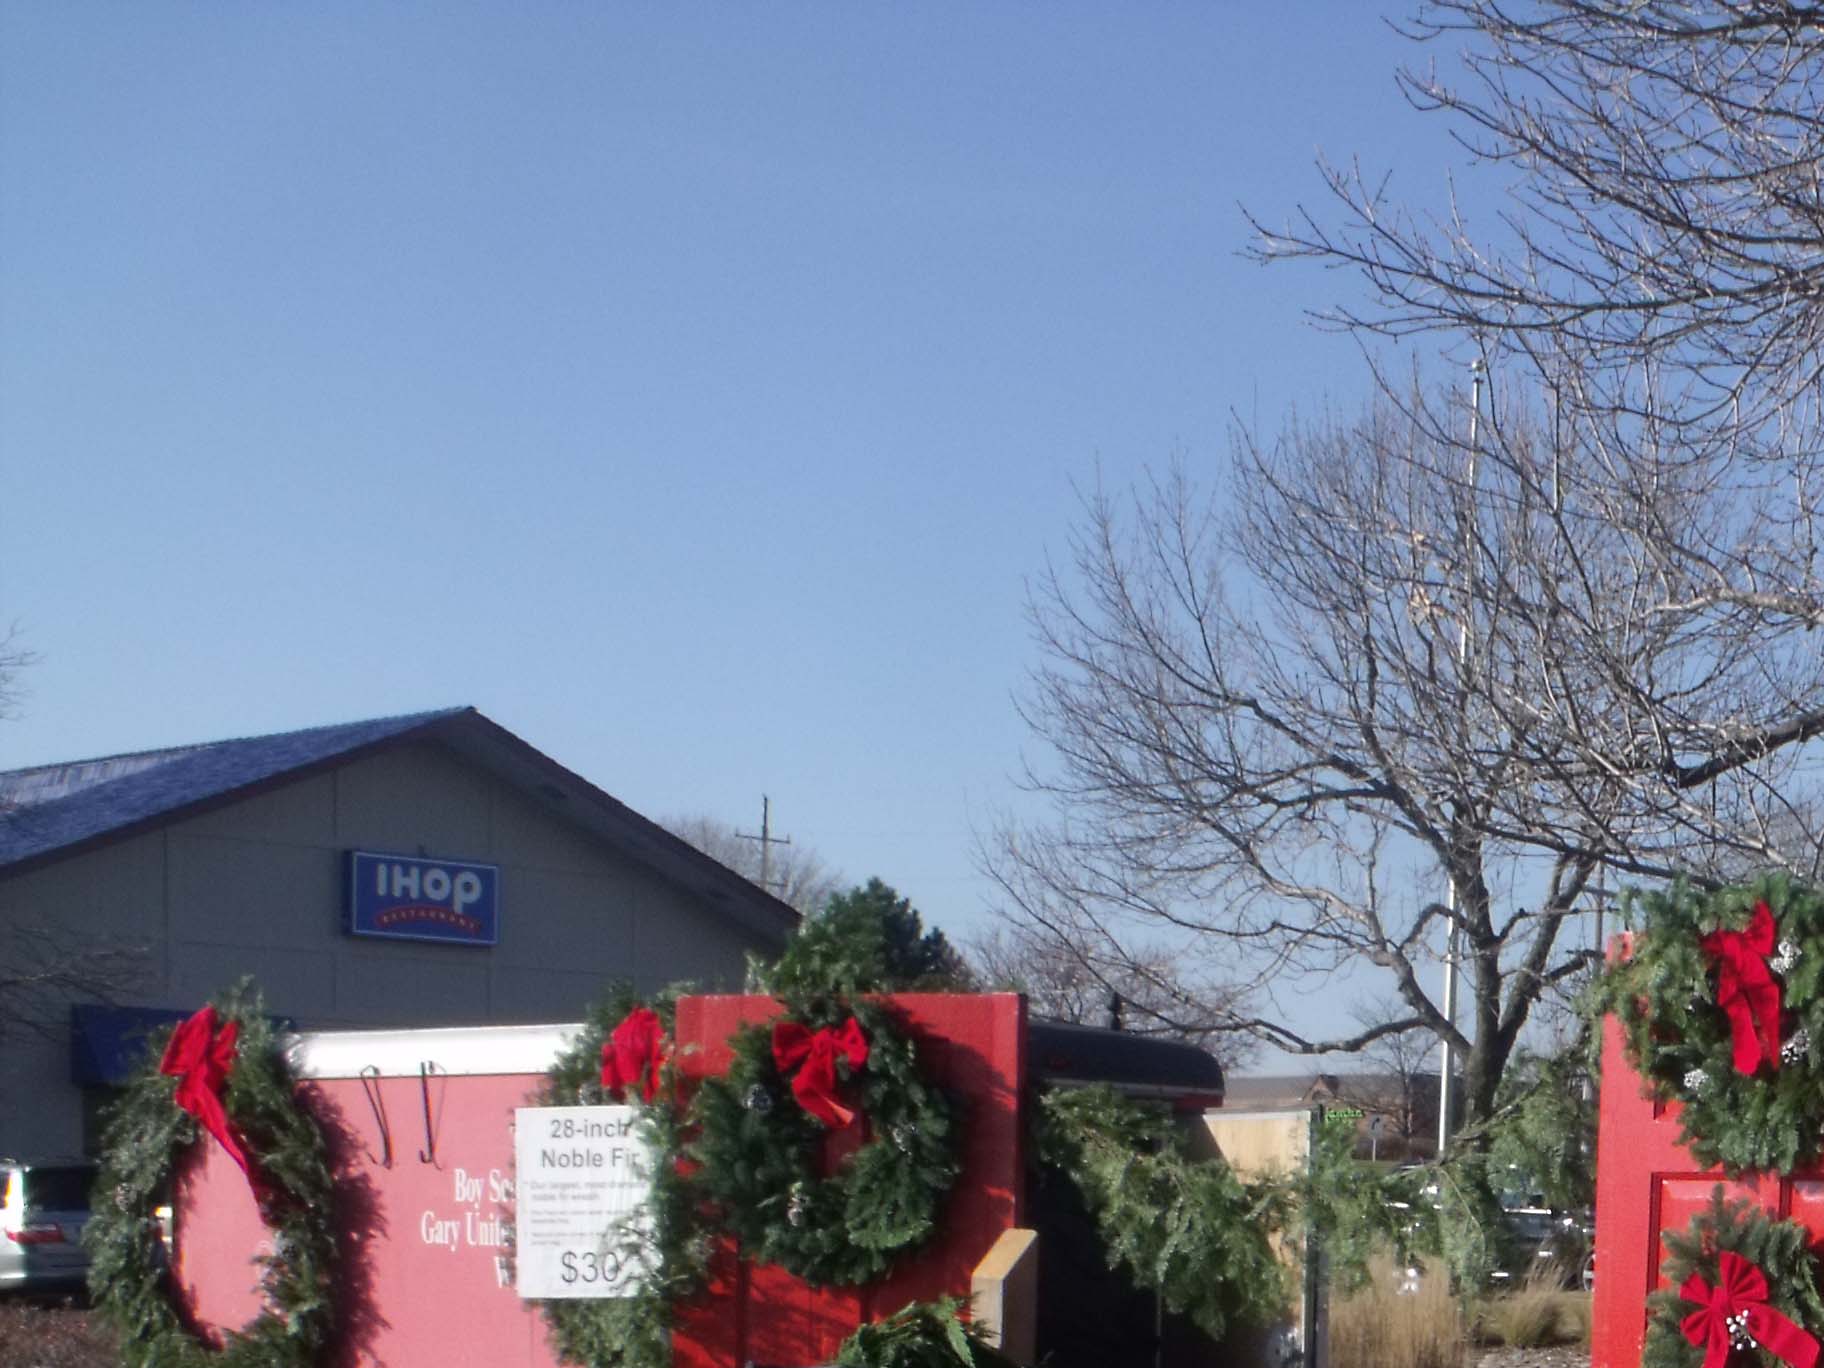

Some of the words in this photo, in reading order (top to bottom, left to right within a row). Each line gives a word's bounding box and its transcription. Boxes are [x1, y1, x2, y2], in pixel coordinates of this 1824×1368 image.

[541, 1147, 604, 1169] Noble
[611, 1147, 641, 1169] Fir
[454, 1168, 484, 1209] Boy
[421, 1210, 460, 1251] Gary
